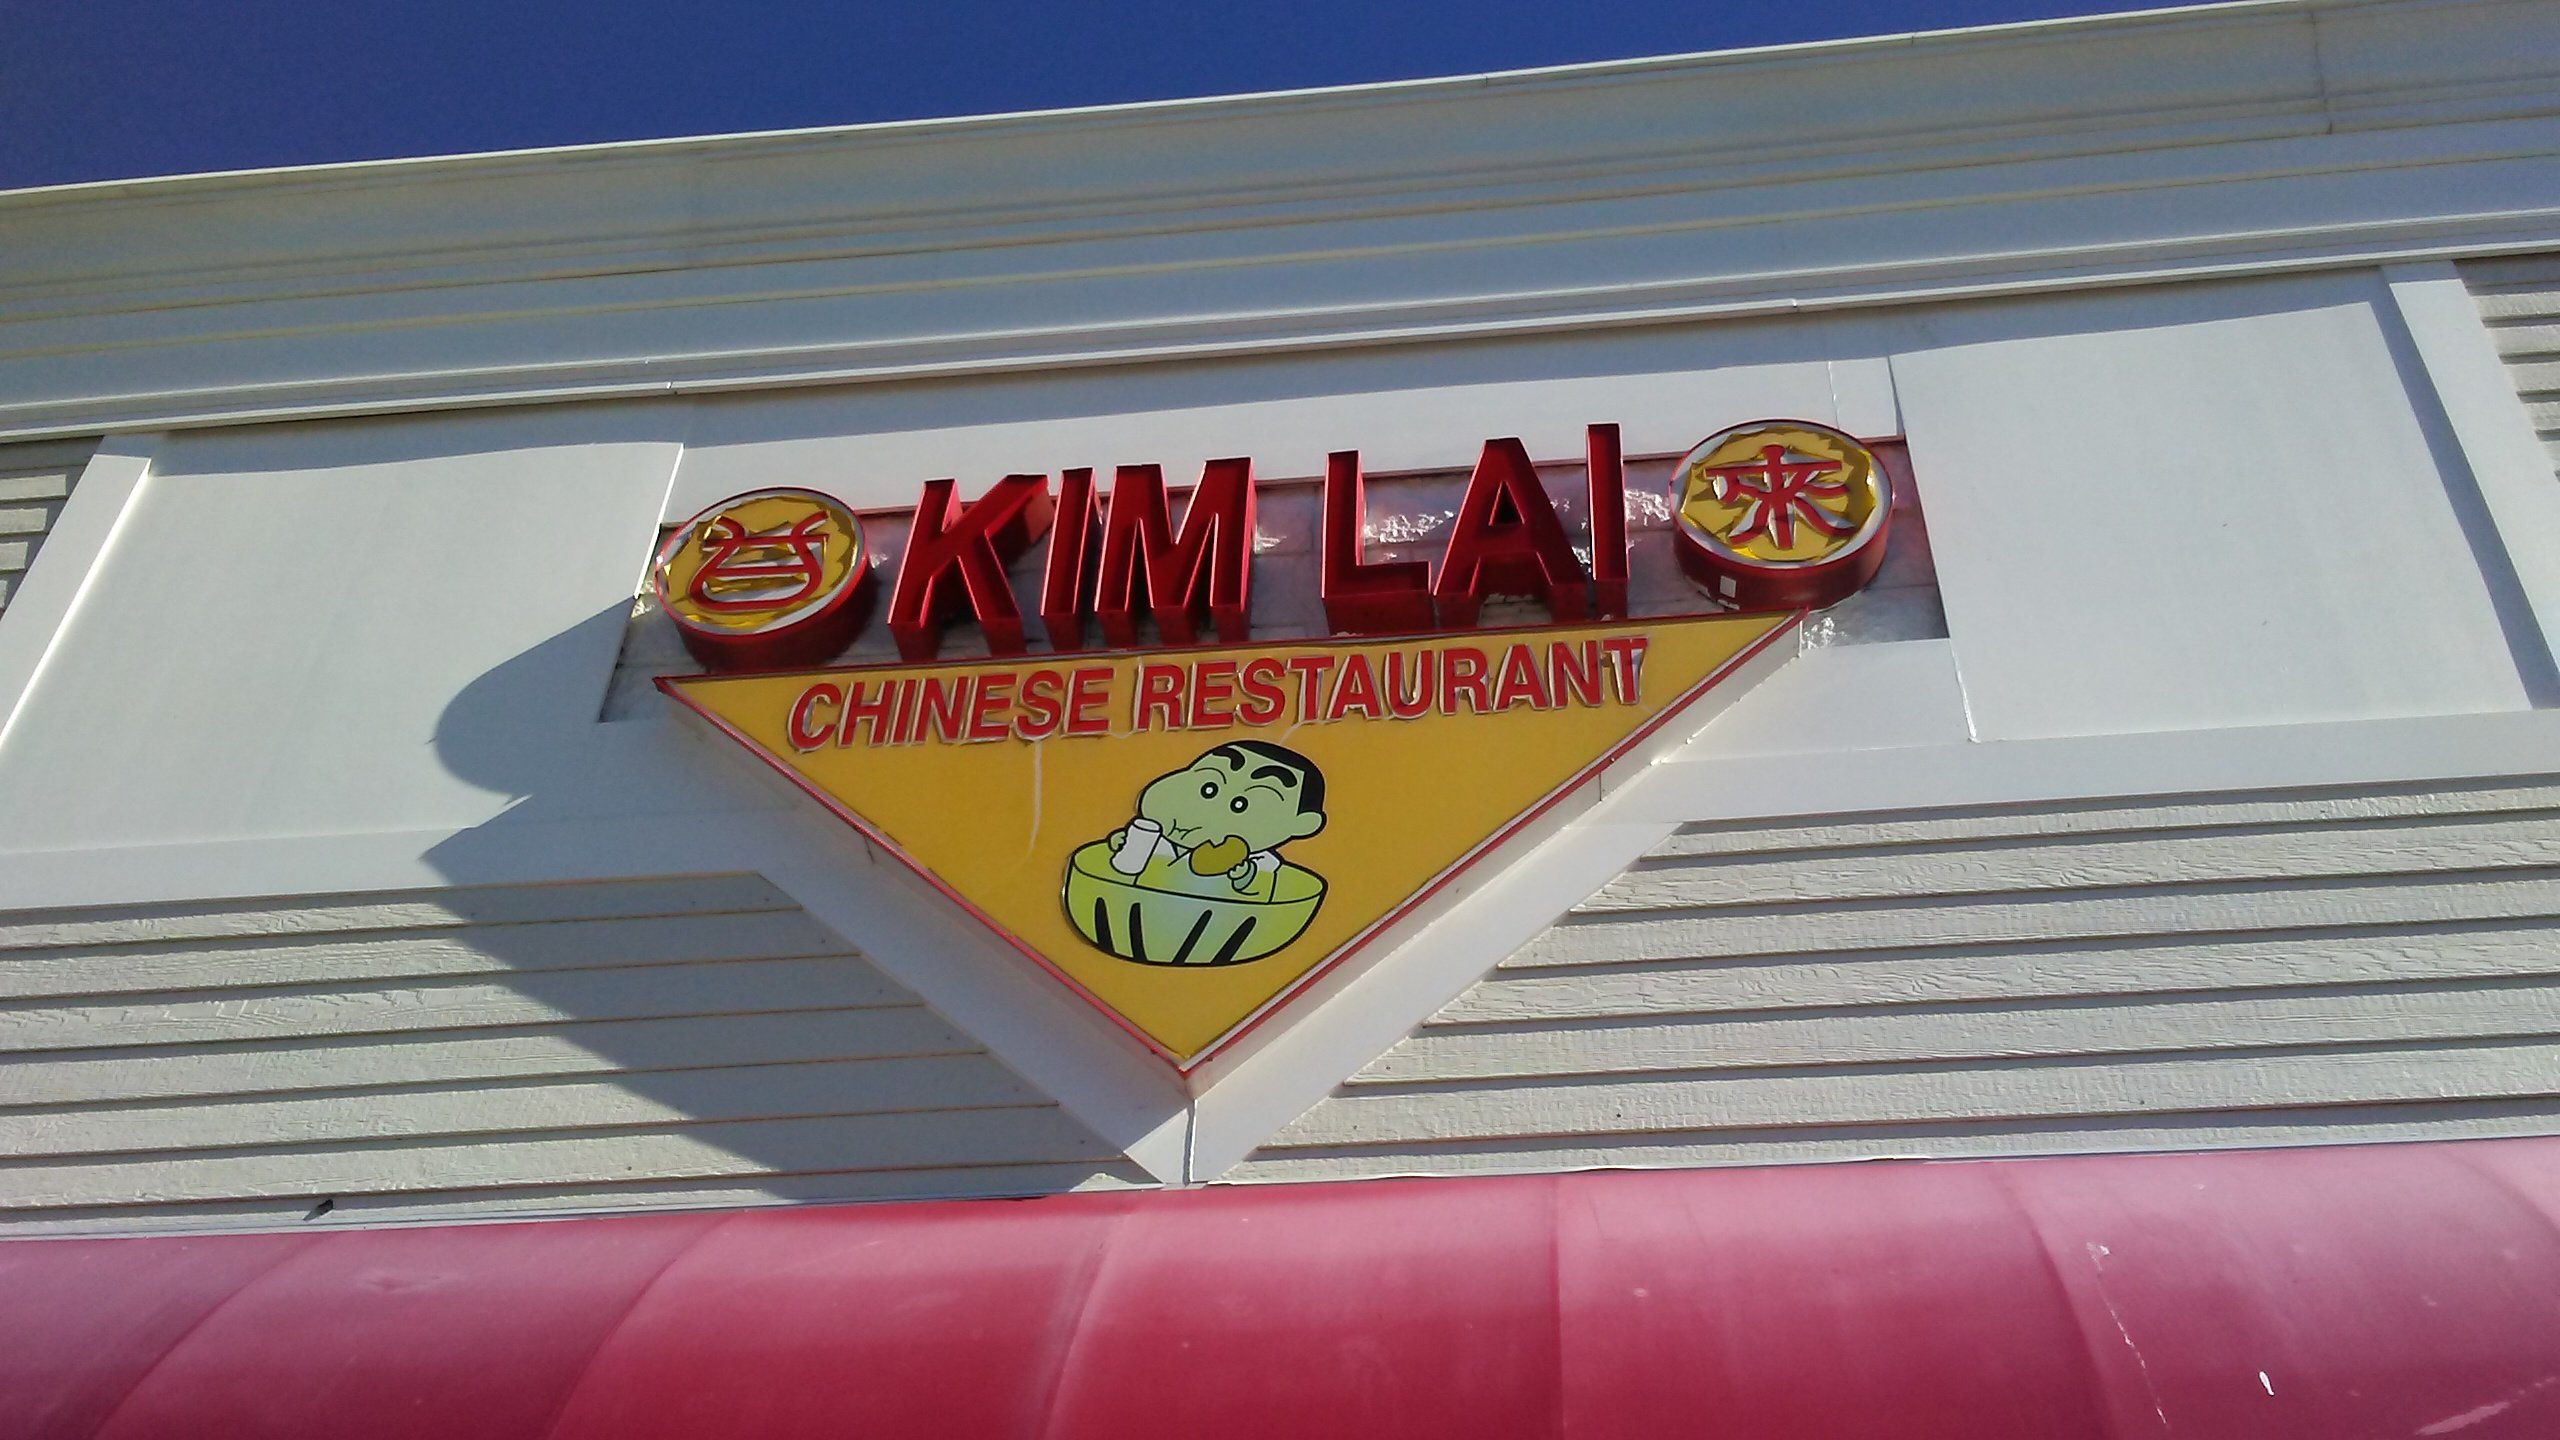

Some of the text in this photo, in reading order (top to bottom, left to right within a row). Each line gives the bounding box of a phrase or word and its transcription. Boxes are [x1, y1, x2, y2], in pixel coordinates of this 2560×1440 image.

[887, 422, 1631, 638] KIM LAI
[1703, 444, 1857, 550] 來
[787, 637, 1648, 752] CHINESE RESTAURANT
